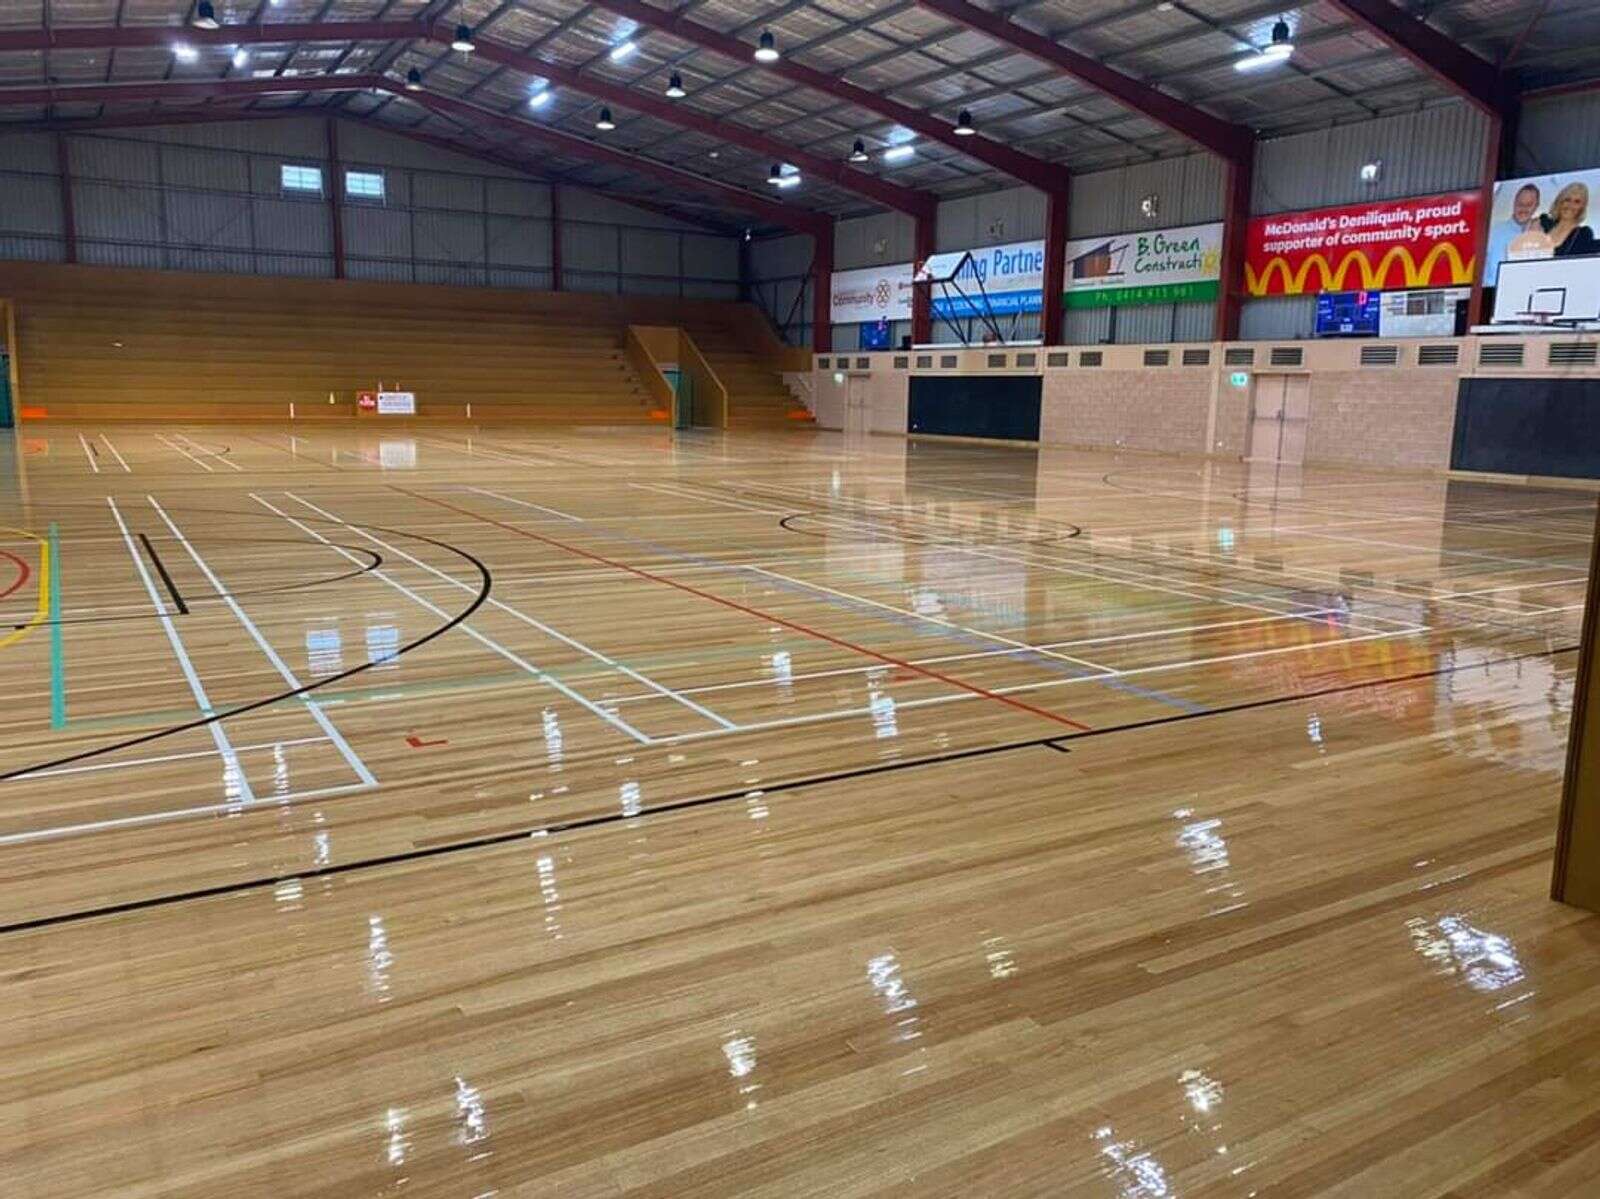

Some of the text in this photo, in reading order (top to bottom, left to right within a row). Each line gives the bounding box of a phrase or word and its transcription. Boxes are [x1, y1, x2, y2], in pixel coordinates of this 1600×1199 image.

[1264, 201, 1461, 236] McDonald's Deniliquin, proud
[1137, 233, 1200, 256] B. Green
[1263, 220, 1470, 254] supporter of community sport.
